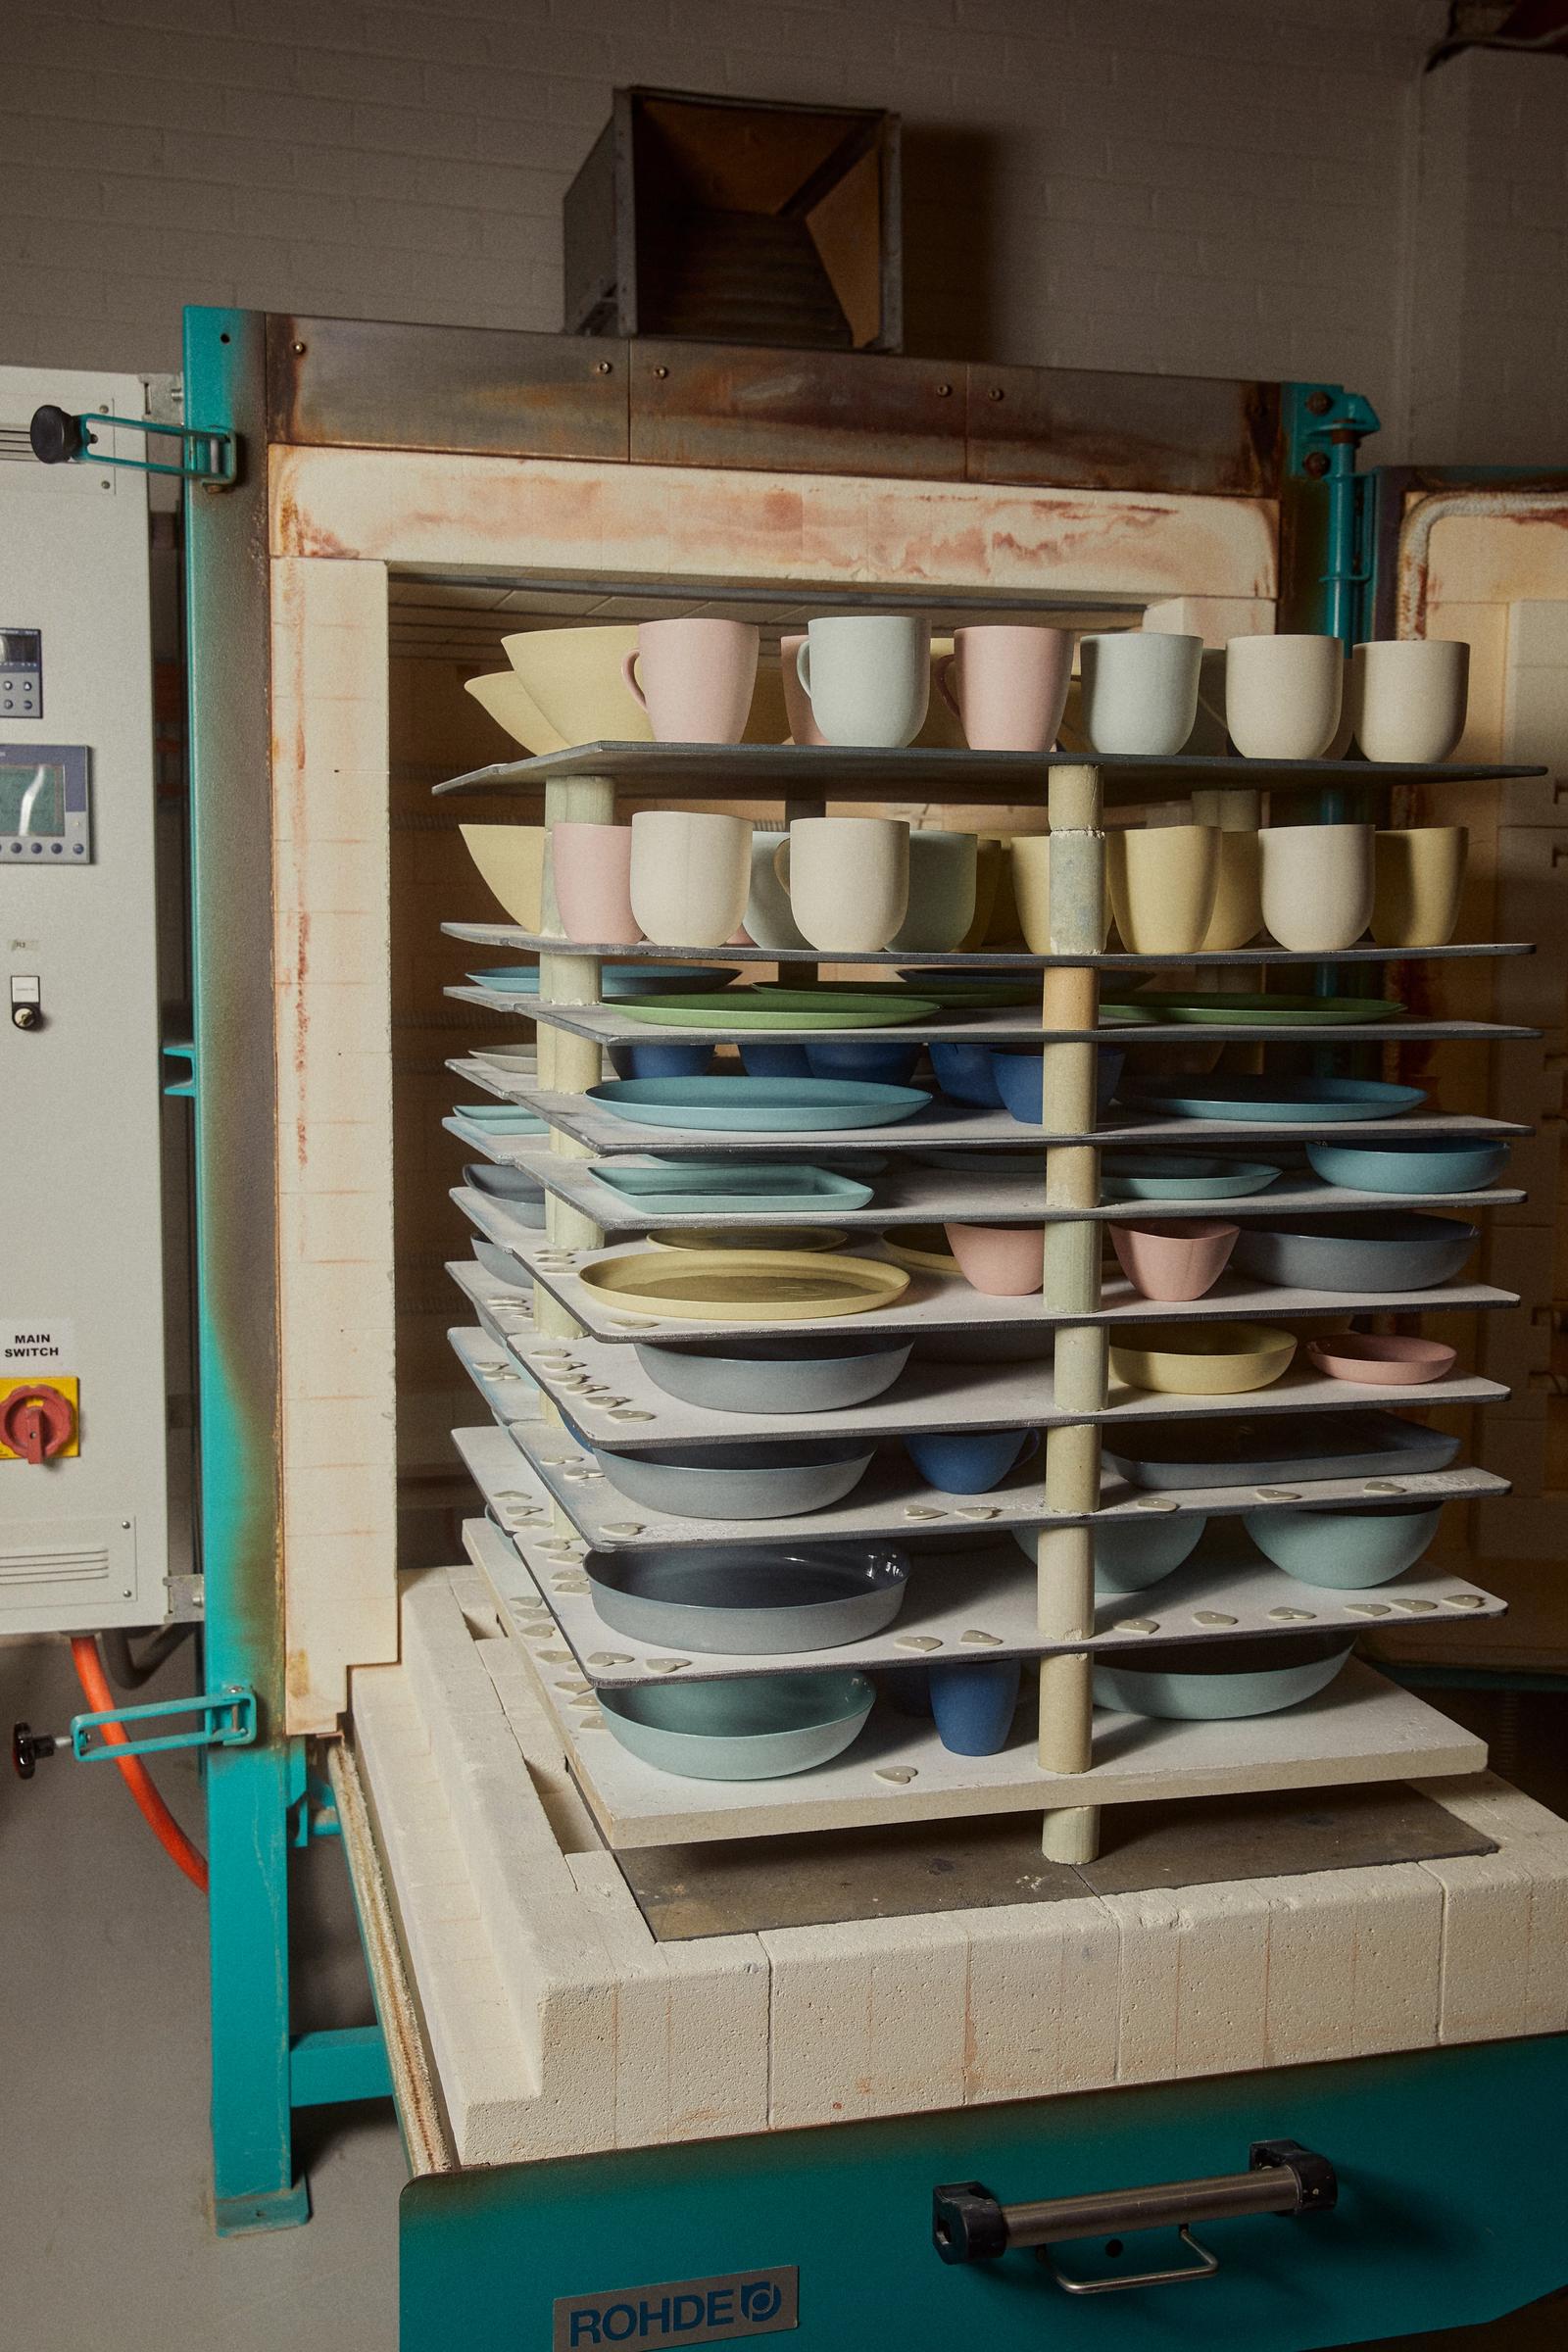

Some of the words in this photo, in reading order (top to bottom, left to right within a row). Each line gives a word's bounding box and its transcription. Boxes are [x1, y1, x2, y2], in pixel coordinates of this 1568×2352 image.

[15, 1334, 51, 1344] MAIN
[5, 1347, 59, 1357] SWITCH
[570, 2289, 734, 2347] ROHDE
